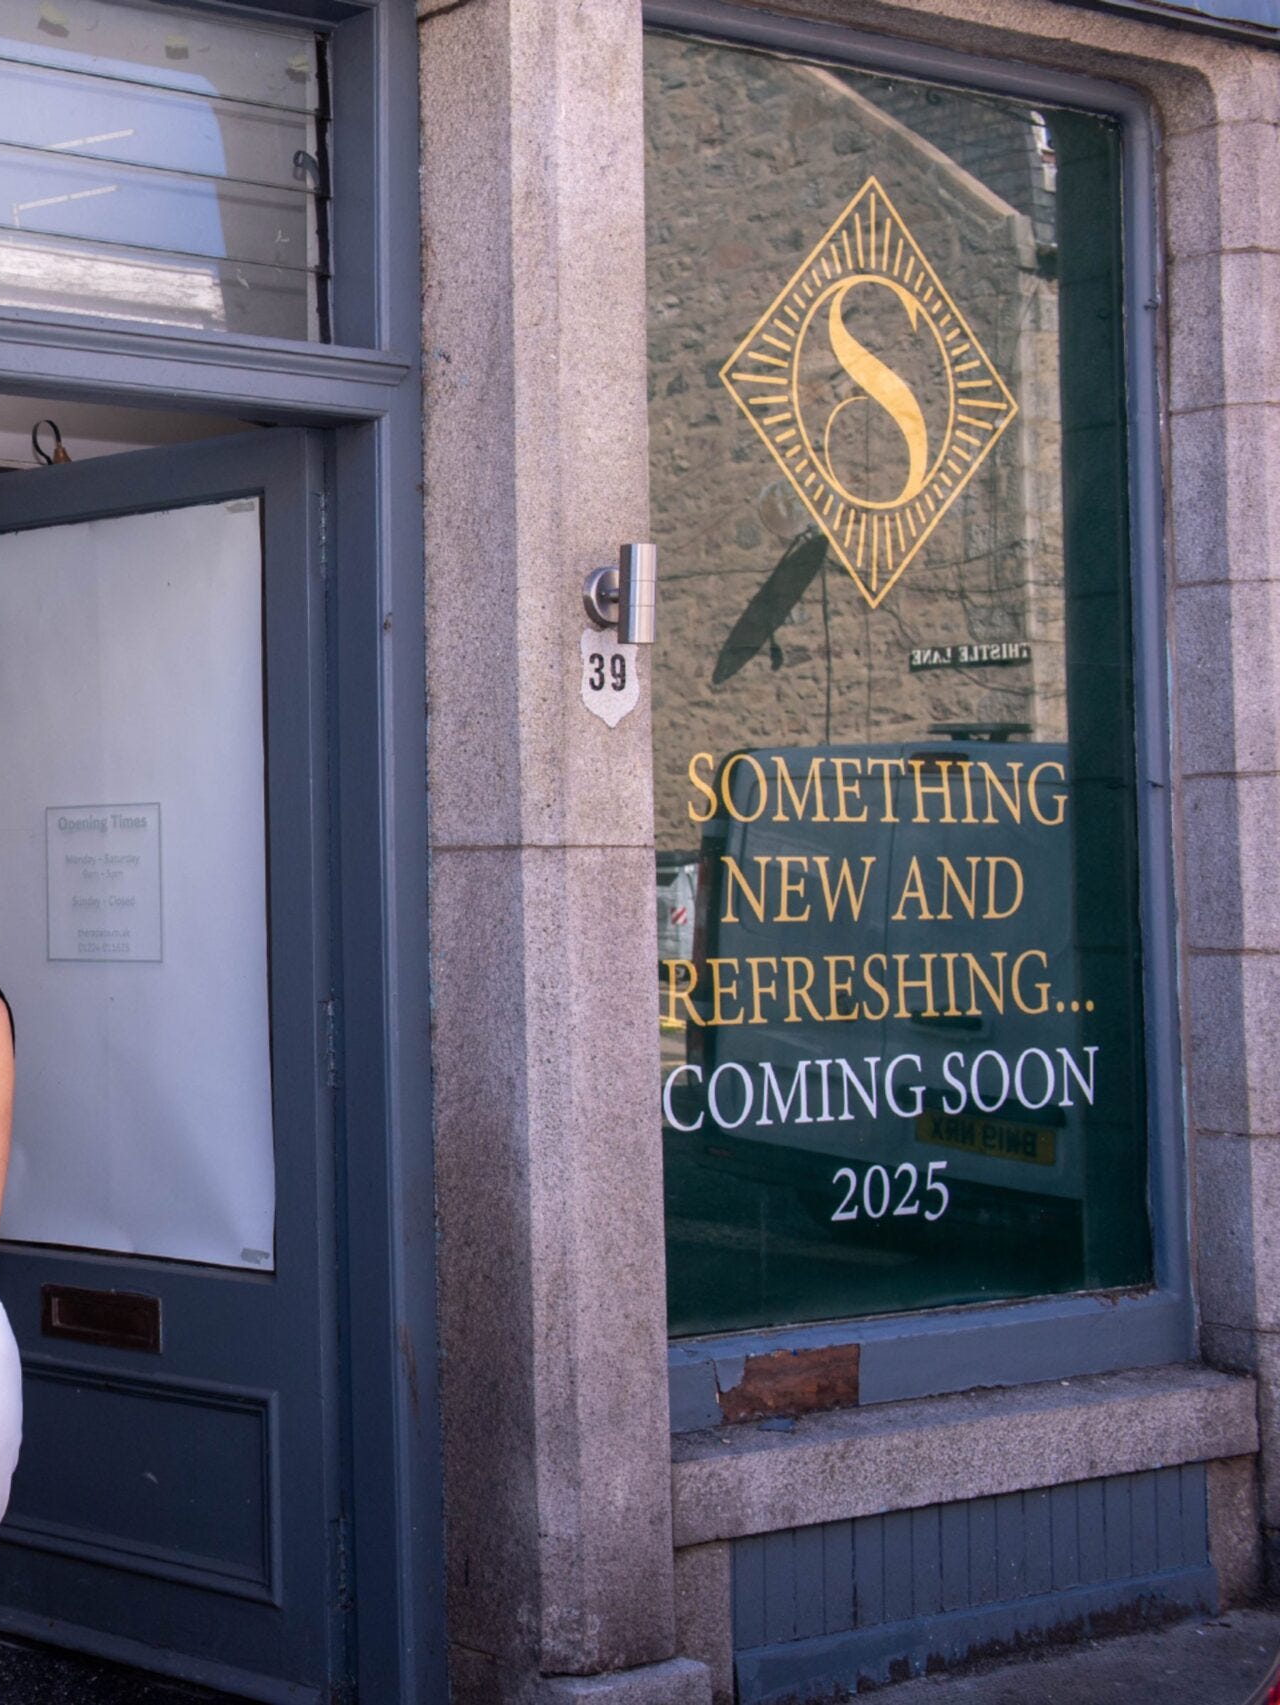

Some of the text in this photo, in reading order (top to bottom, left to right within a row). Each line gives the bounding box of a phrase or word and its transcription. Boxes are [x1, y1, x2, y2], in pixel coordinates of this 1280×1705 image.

[824, 273, 929, 510] S
[588, 652, 627, 692] 39
[58, 813, 148, 834] Opening Times
[687, 752, 1068, 826] SOMETHING
[720, 856, 1023, 923] NEW AND
[662, 949, 1095, 1028] REFRESHING...
[662, 1046, 1099, 1132] COMING SOON
[831, 1160, 950, 1222] 2025
